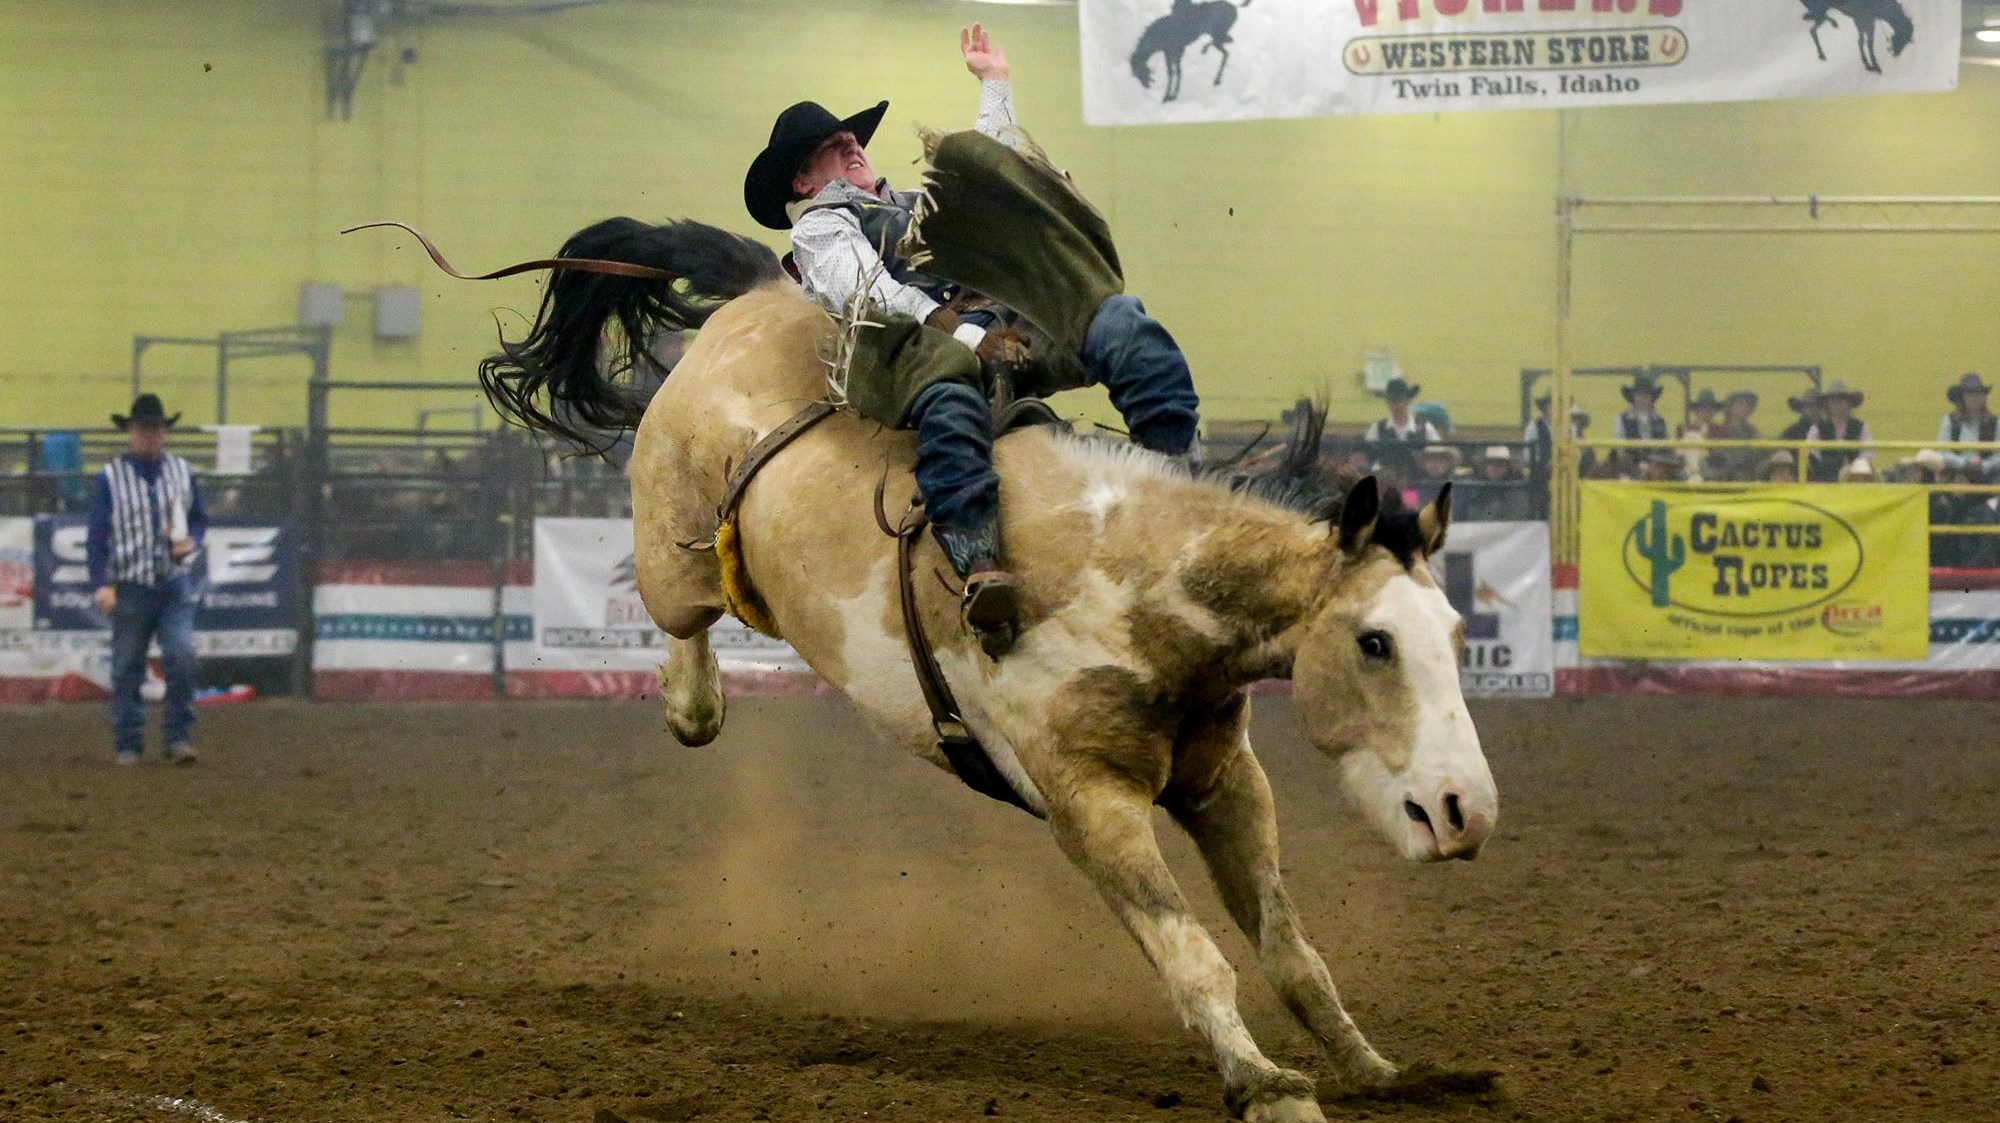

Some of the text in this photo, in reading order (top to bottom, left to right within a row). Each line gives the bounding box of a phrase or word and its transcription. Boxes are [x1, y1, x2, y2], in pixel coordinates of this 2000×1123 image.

[1380, 34, 1650, 70] WESTERN STORE
[1392, 73, 1641, 99] Twin Falls, Idaho
